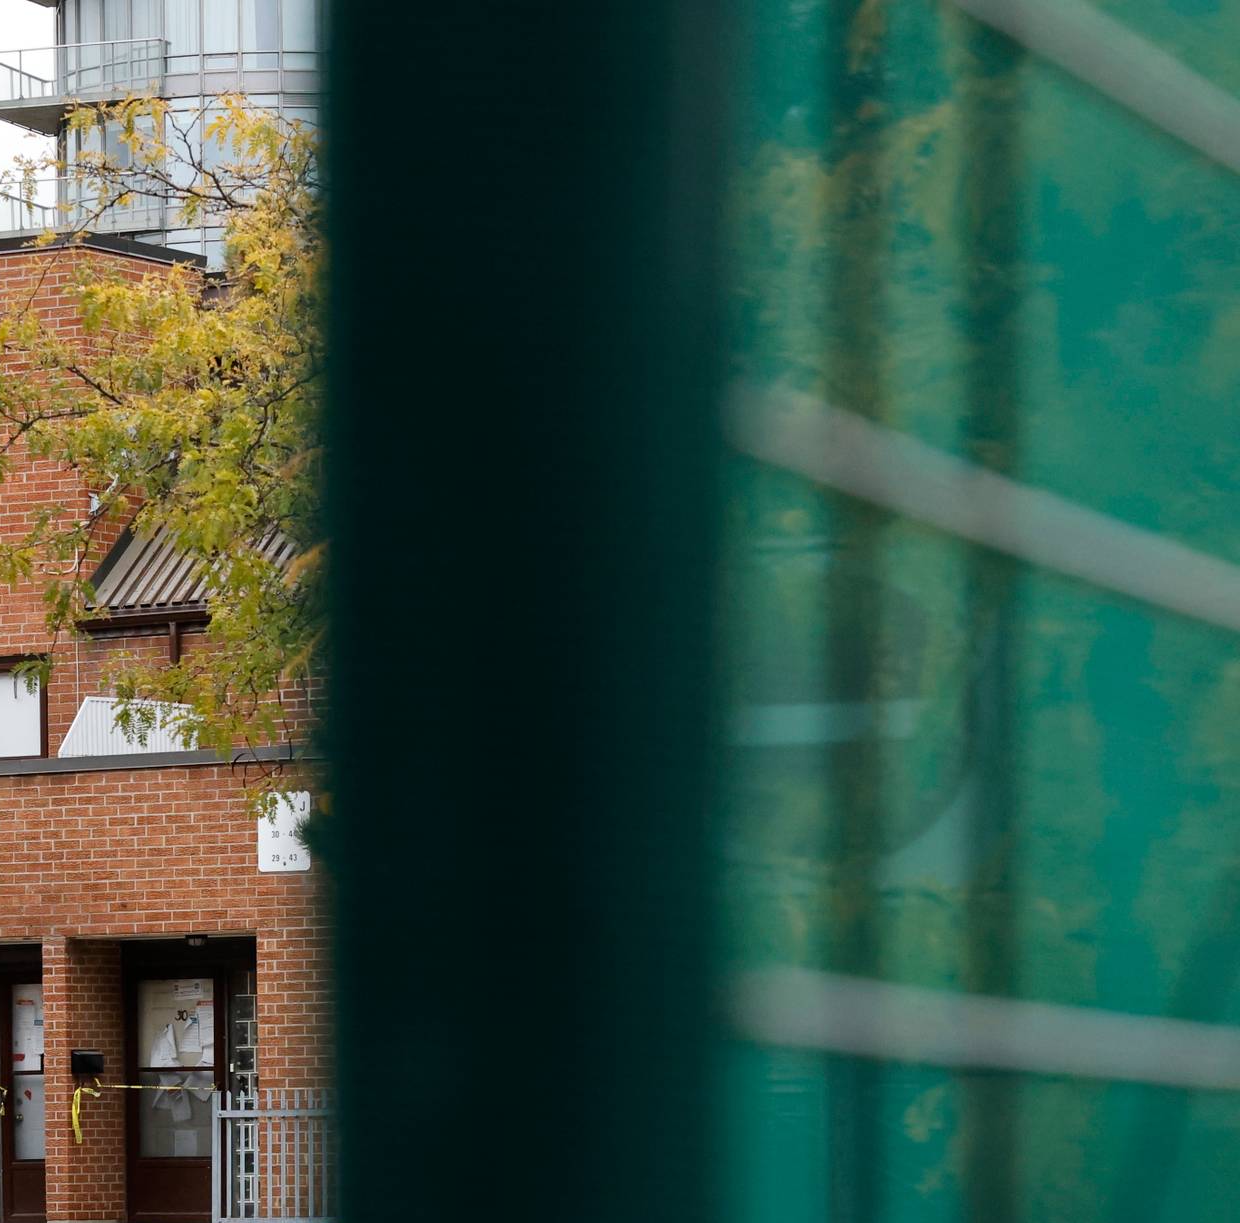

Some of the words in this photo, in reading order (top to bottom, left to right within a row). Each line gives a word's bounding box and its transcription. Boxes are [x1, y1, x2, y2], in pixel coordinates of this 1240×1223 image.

[300, 800, 306, 812] J
[272, 830, 280, 838] 30
[272, 854, 280, 862] 29
[288, 854, 298, 862] 43
[174, 1009, 188, 1022] 30
